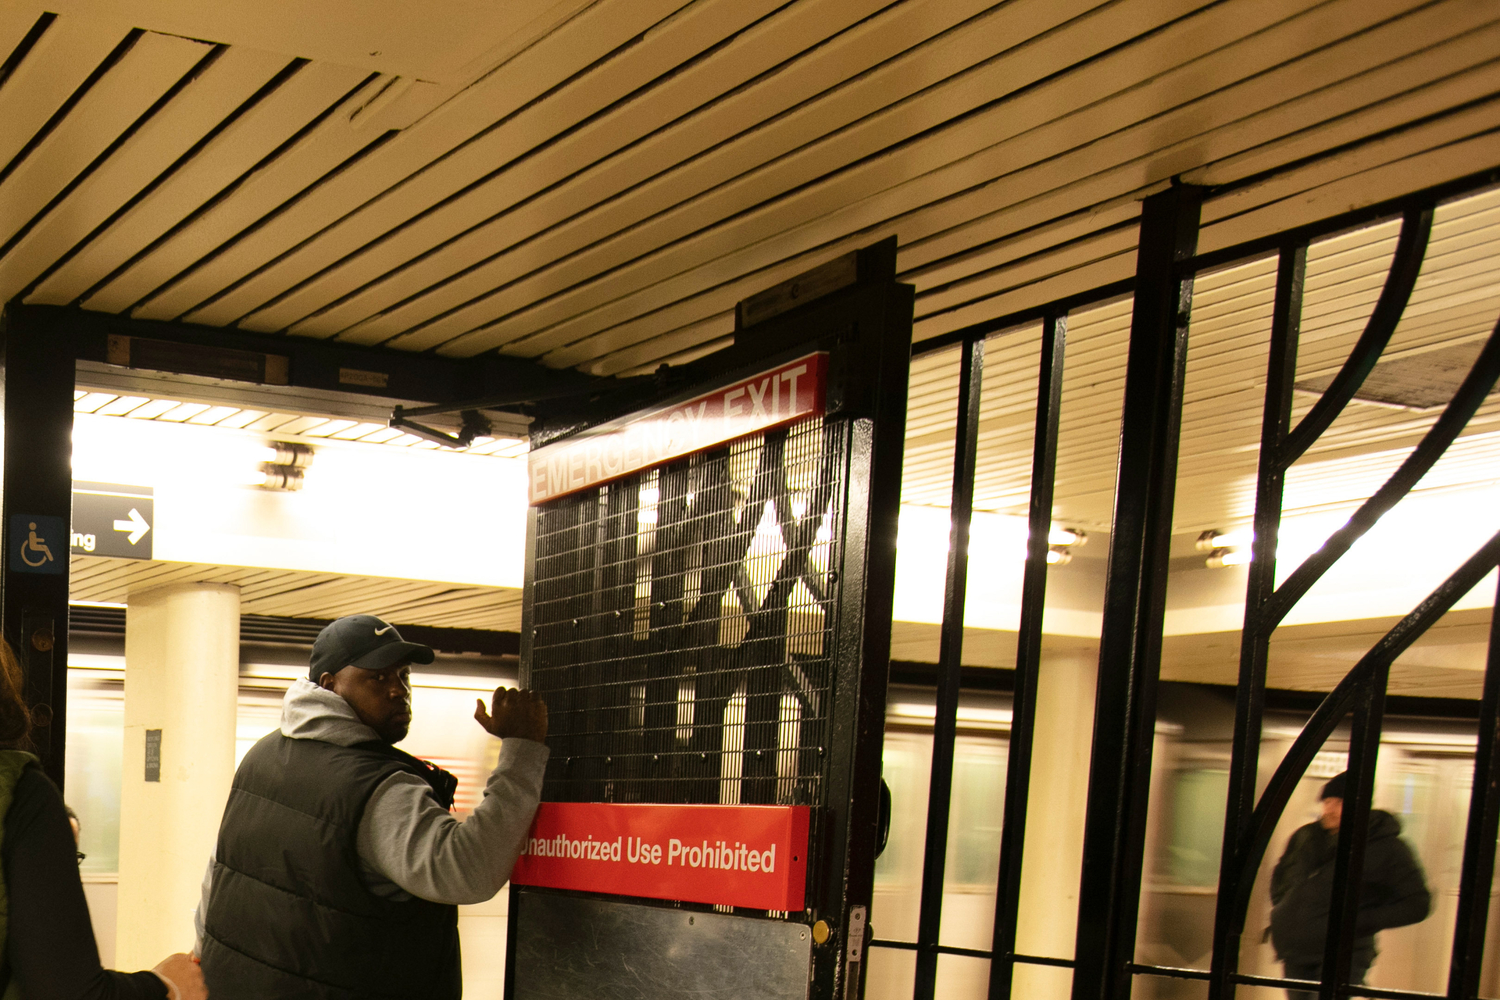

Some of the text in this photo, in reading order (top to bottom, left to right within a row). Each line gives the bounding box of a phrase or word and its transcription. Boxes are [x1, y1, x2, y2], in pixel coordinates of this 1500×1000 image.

[723, 364, 808, 434] EXIT
[626, 836, 662, 865] Use
[667, 838, 776, 873] Prohibited
